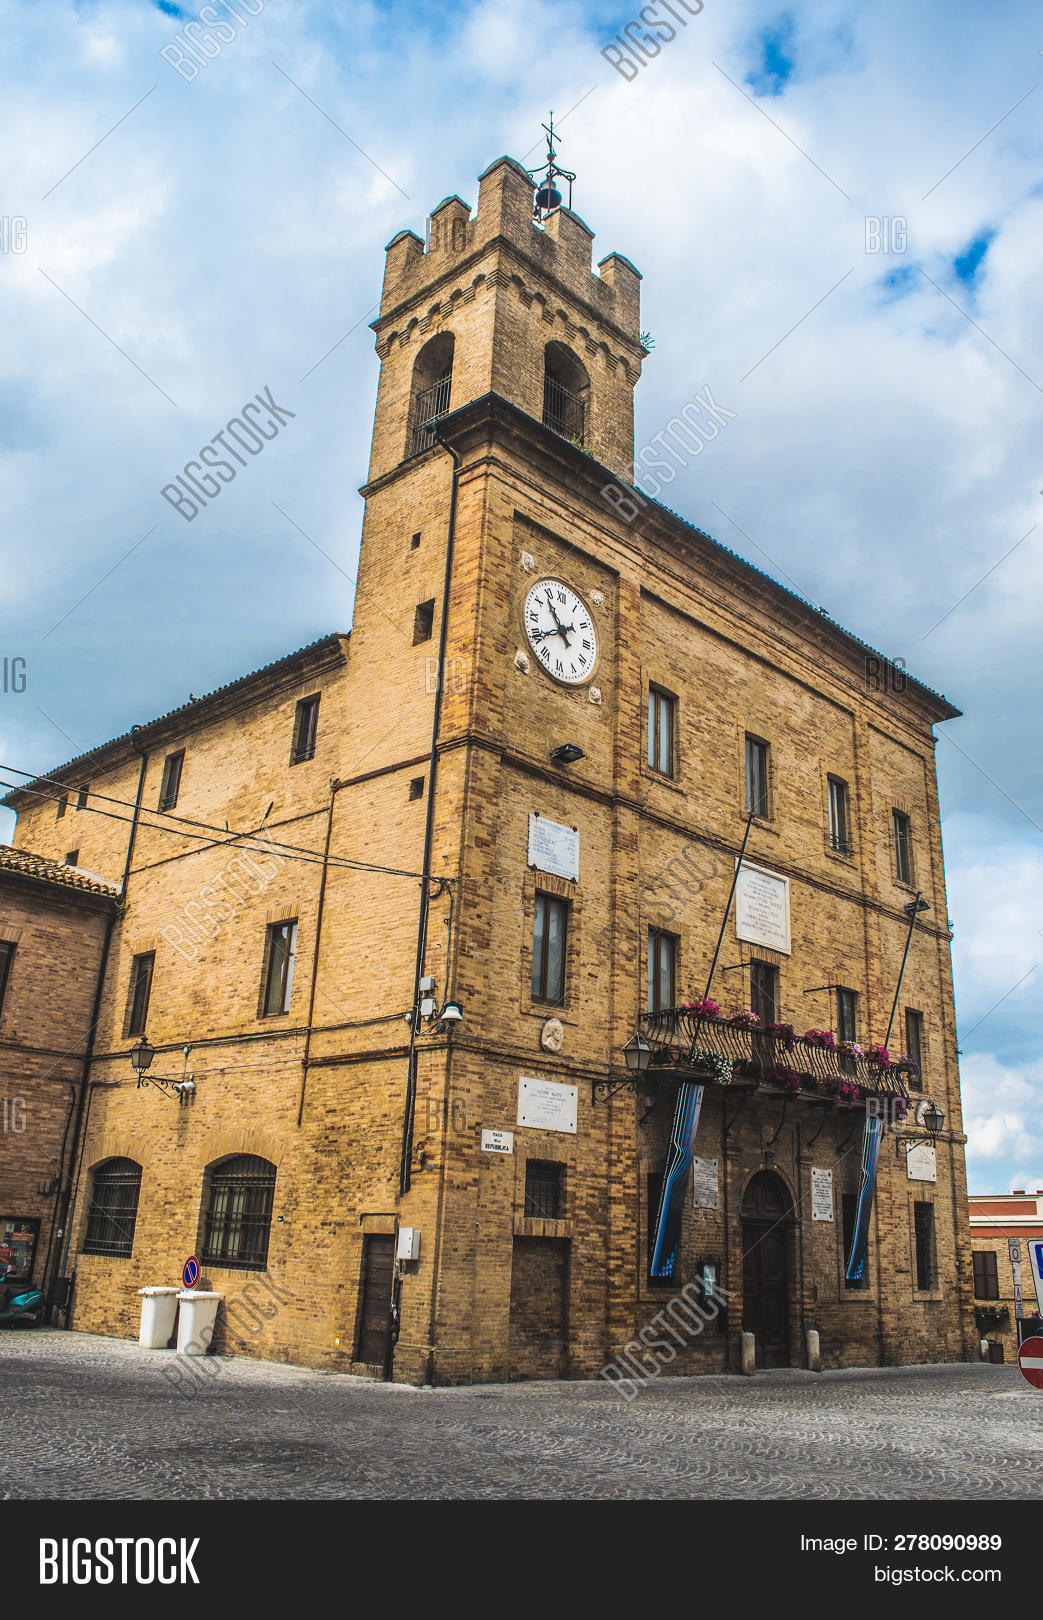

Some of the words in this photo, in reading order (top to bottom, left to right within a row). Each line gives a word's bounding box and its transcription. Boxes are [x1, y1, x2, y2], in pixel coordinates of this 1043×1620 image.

[534, 595, 544, 608] X
[556, 590, 567, 605] XII
[579, 621, 588, 629] II
[582, 638, 591, 650] III
[540, 646, 550, 662] VII
[556, 659, 564, 673] VI
[570, 662, 577, 674] V
